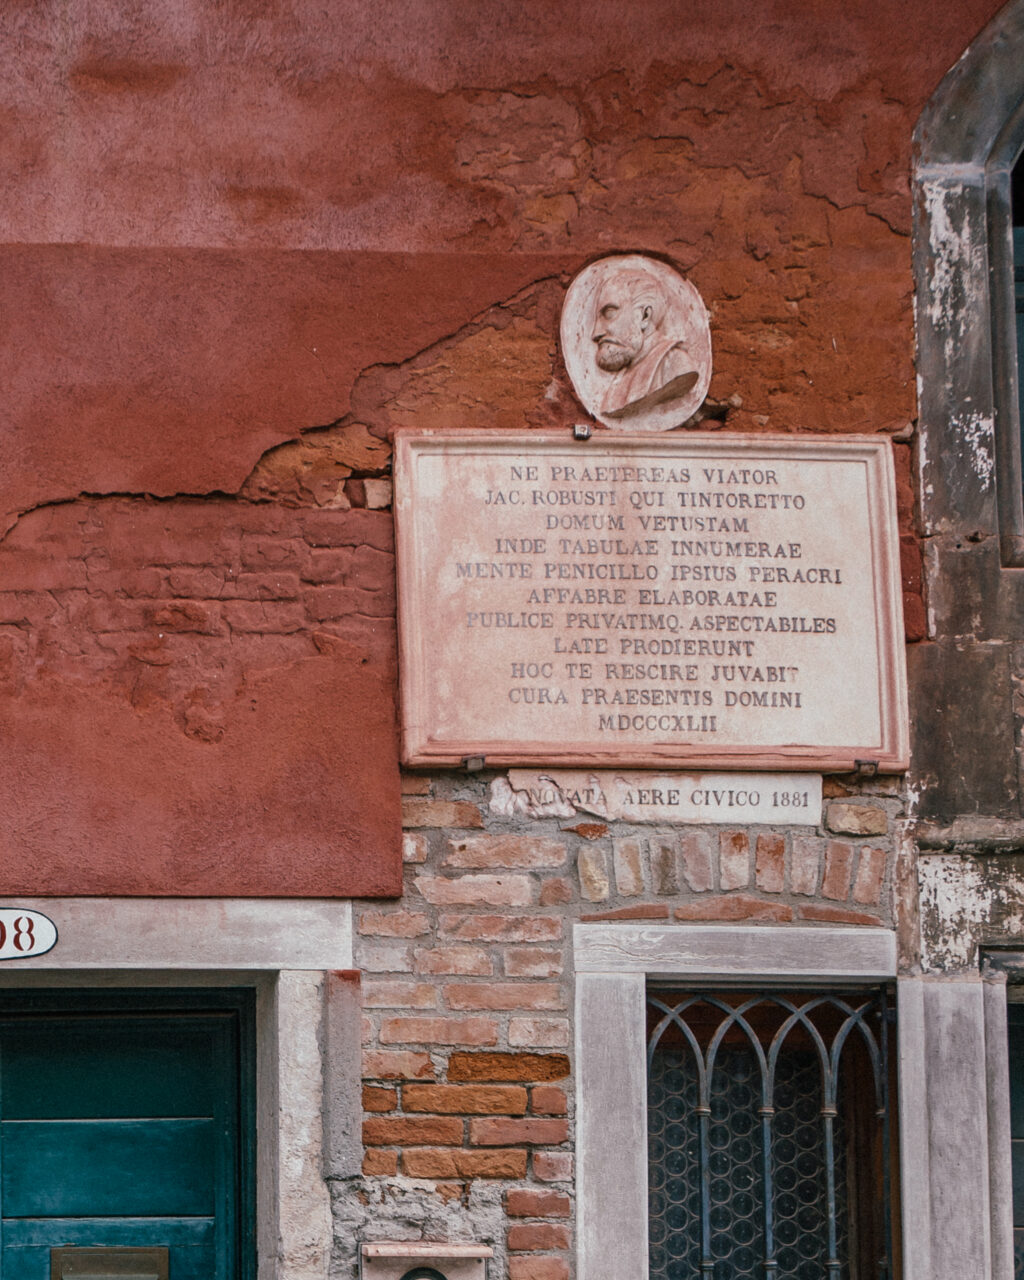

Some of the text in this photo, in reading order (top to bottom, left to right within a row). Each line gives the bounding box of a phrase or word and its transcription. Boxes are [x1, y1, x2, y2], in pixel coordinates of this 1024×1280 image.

[511, 466, 778, 485] NE PRAETEREAS VIATOR
[485, 490, 805, 510] JAC. ROBUSTI QUI TINTORETTO
[546, 514, 750, 533] DOMUM VETUSTAM
[495, 538, 802, 558] INDE TABULAE INNUMERAE
[456, 562, 842, 584] MENTE PENICILLO IPSIUS PERACRI
[527, 588, 778, 607] AFFABRE ELABORATAE
[466, 612, 554, 628] PUBLICE
[689, 615, 837, 633] ASPECTABILES
[554, 637, 755, 657] LATE PRODIERUNT
[511, 663, 553, 679] HOC
[565, 663, 592, 679] TE
[605, 663, 698, 681] RESCIRE
[509, 688, 802, 708] CURA PRAESENTIS DOMINI
[598, 714, 717, 732] MDCCCXLII
[623, 789, 680, 805] AERE
[690, 790, 761, 806] CIVICO
[772, 791, 809, 807] 1881
